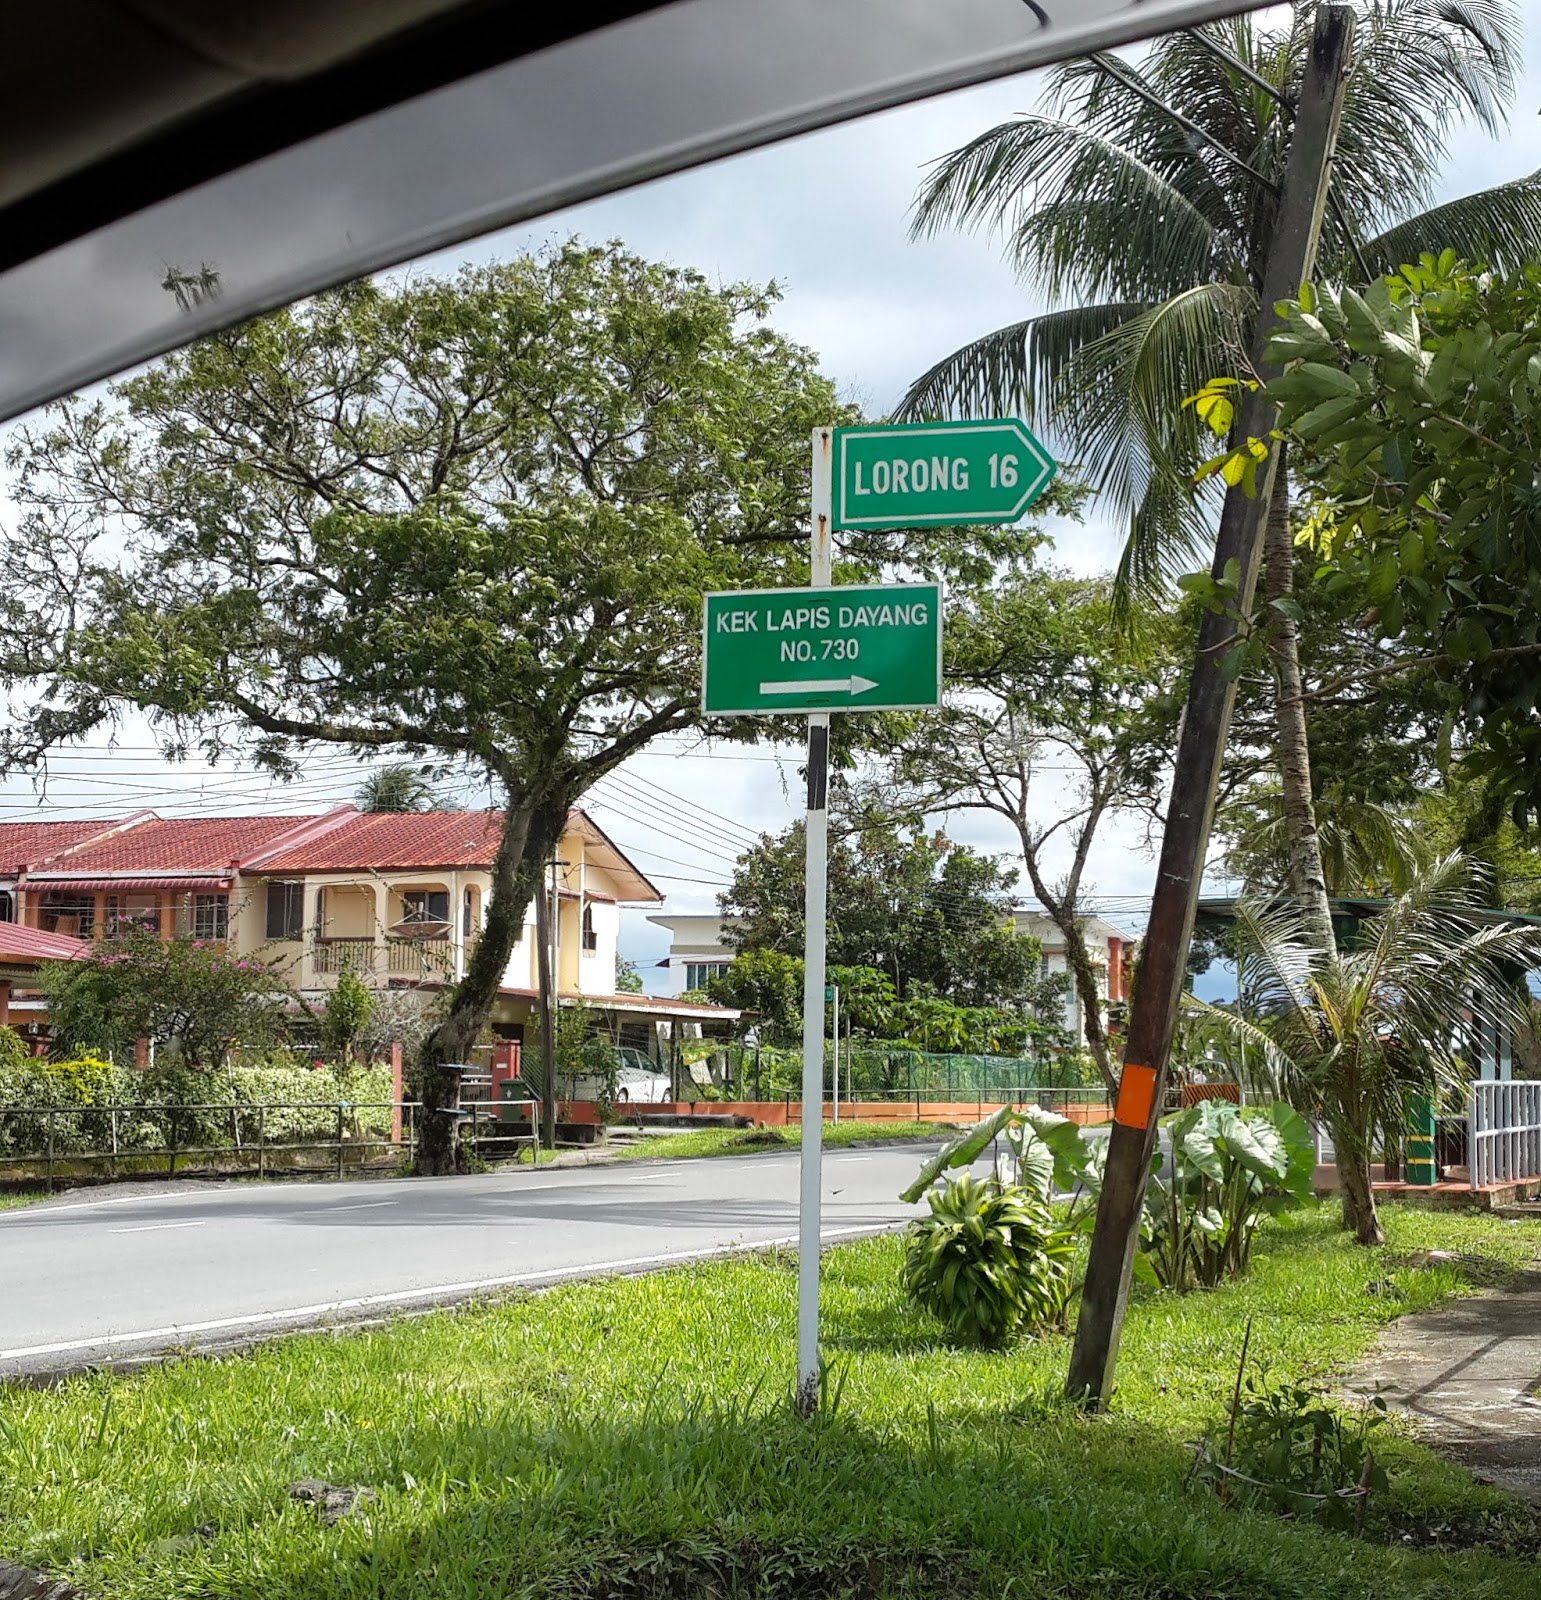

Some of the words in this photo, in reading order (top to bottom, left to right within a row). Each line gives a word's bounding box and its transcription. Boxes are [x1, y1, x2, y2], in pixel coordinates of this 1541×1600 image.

[854, 456, 969, 496] LORONG
[988, 453, 1019, 489] 16
[716, 610, 758, 633] KEK
[766, 606, 831, 631] LAPIS
[838, 603, 928, 628] DAYANG
